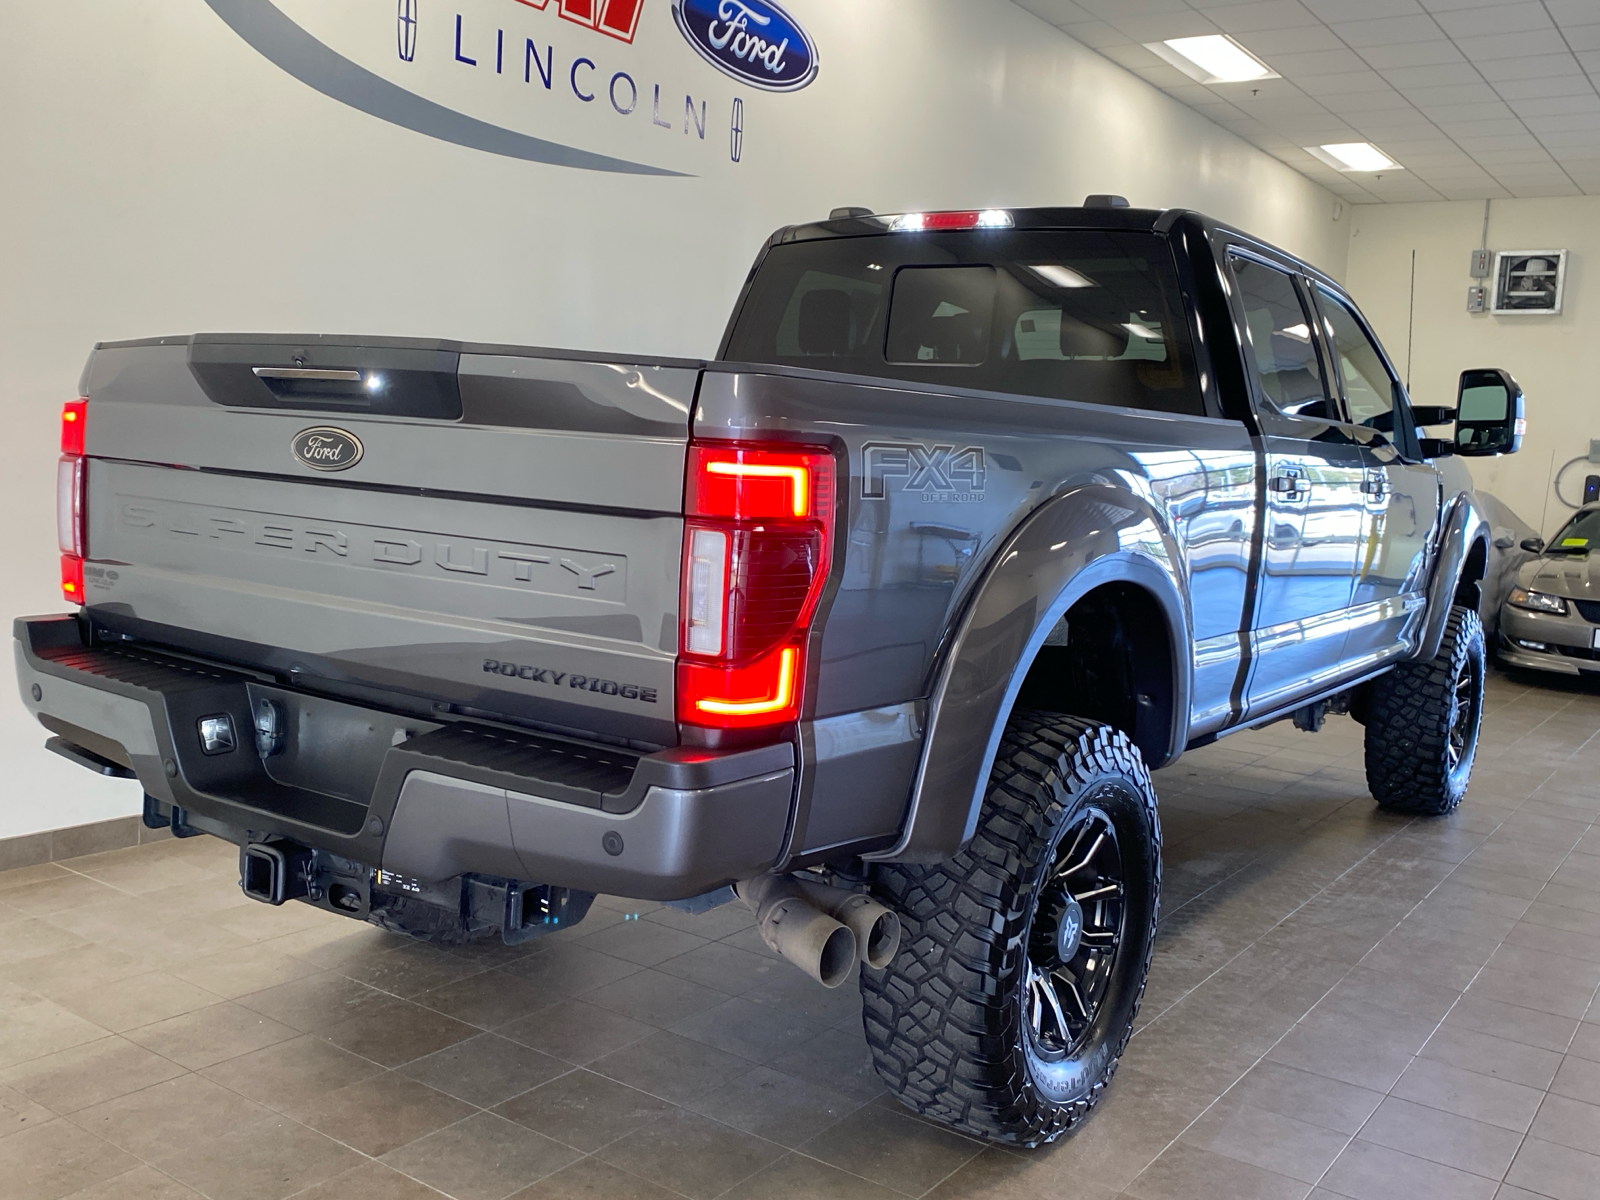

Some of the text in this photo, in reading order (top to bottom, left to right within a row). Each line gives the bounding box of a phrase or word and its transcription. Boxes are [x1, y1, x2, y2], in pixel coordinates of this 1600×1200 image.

[708, 0, 788, 73] Ford
[455, 14, 706, 140] LINCOLN
[303, 435, 343, 460] Ford
[860, 440, 987, 500] FX4
[921, 492, 986, 503] OFF ROAD
[121, 502, 616, 590] SUPER DUTY
[482, 658, 658, 703] ROCKY RIDGE
